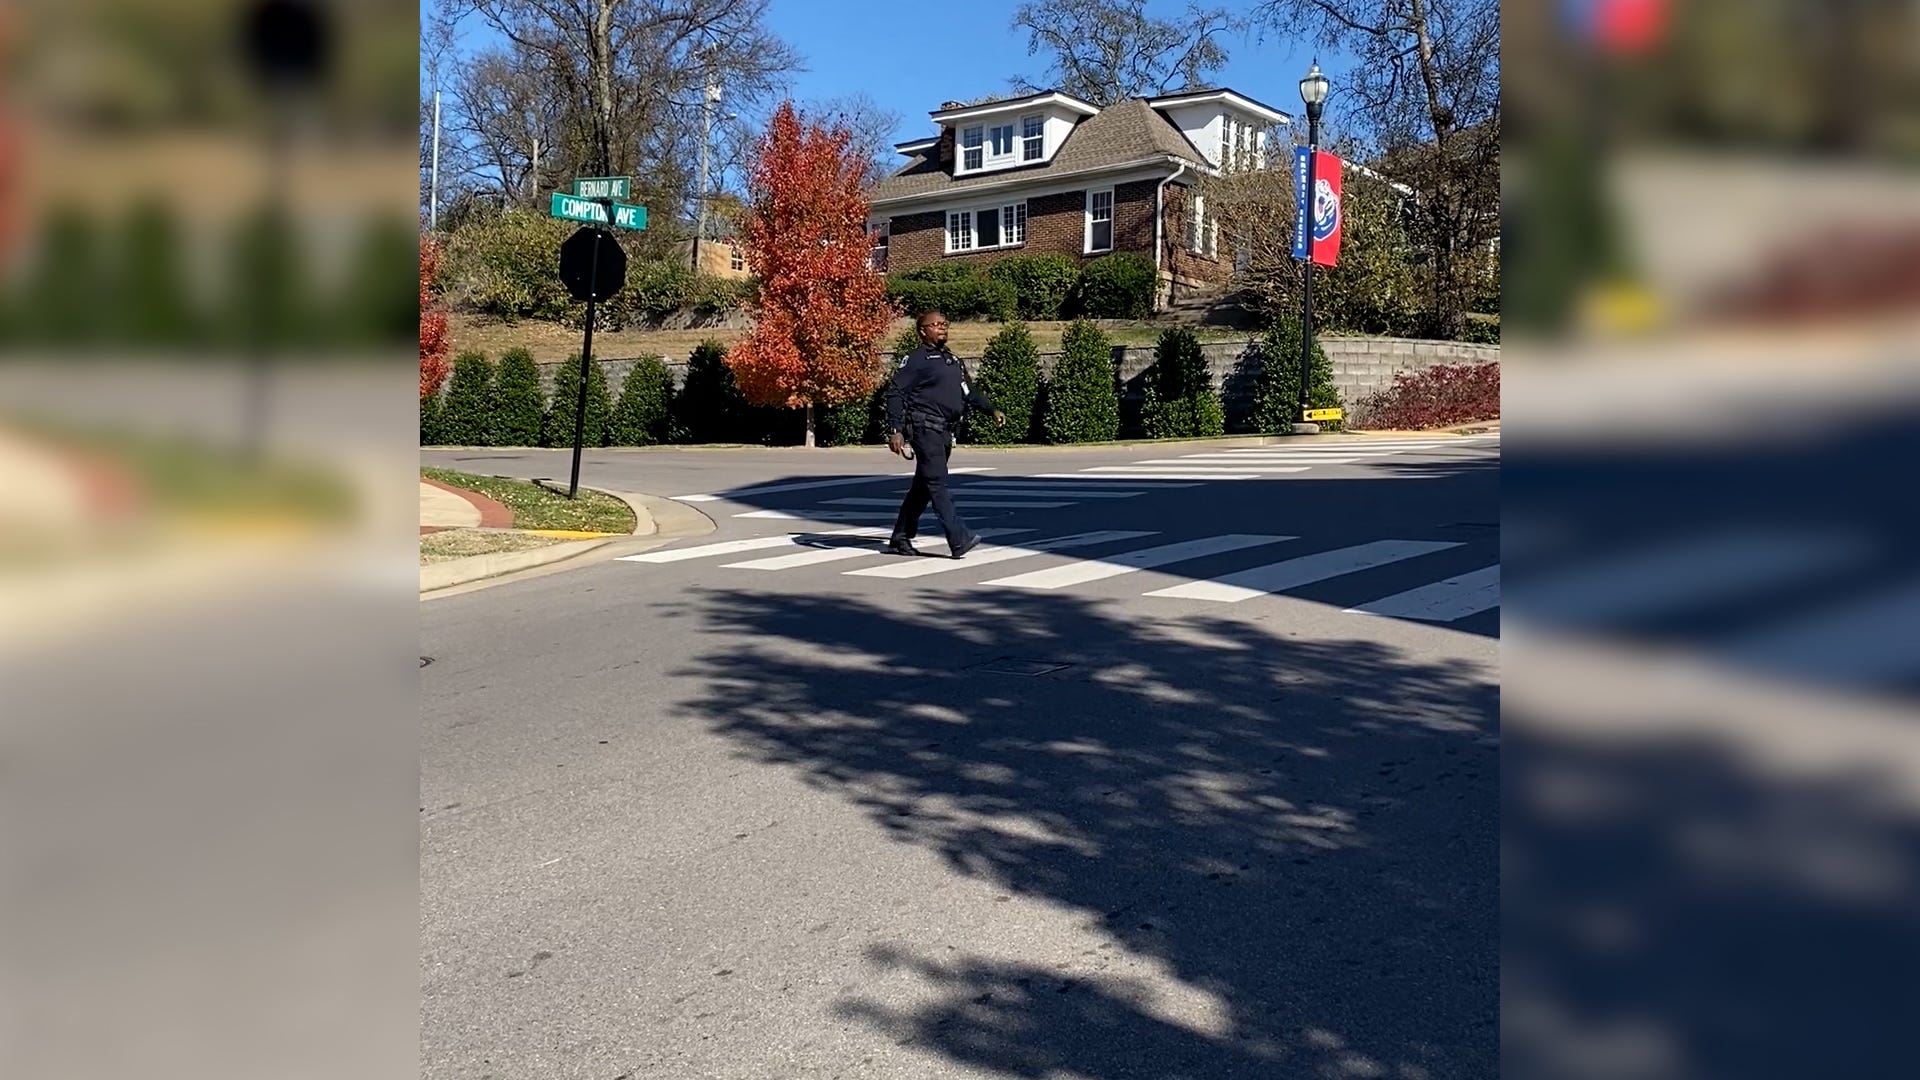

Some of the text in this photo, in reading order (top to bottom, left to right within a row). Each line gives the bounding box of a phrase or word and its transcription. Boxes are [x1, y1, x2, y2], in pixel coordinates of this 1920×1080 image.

[580, 180, 623, 197] BERNARD AVE
[561, 198, 637, 225] COMPTON AVE
